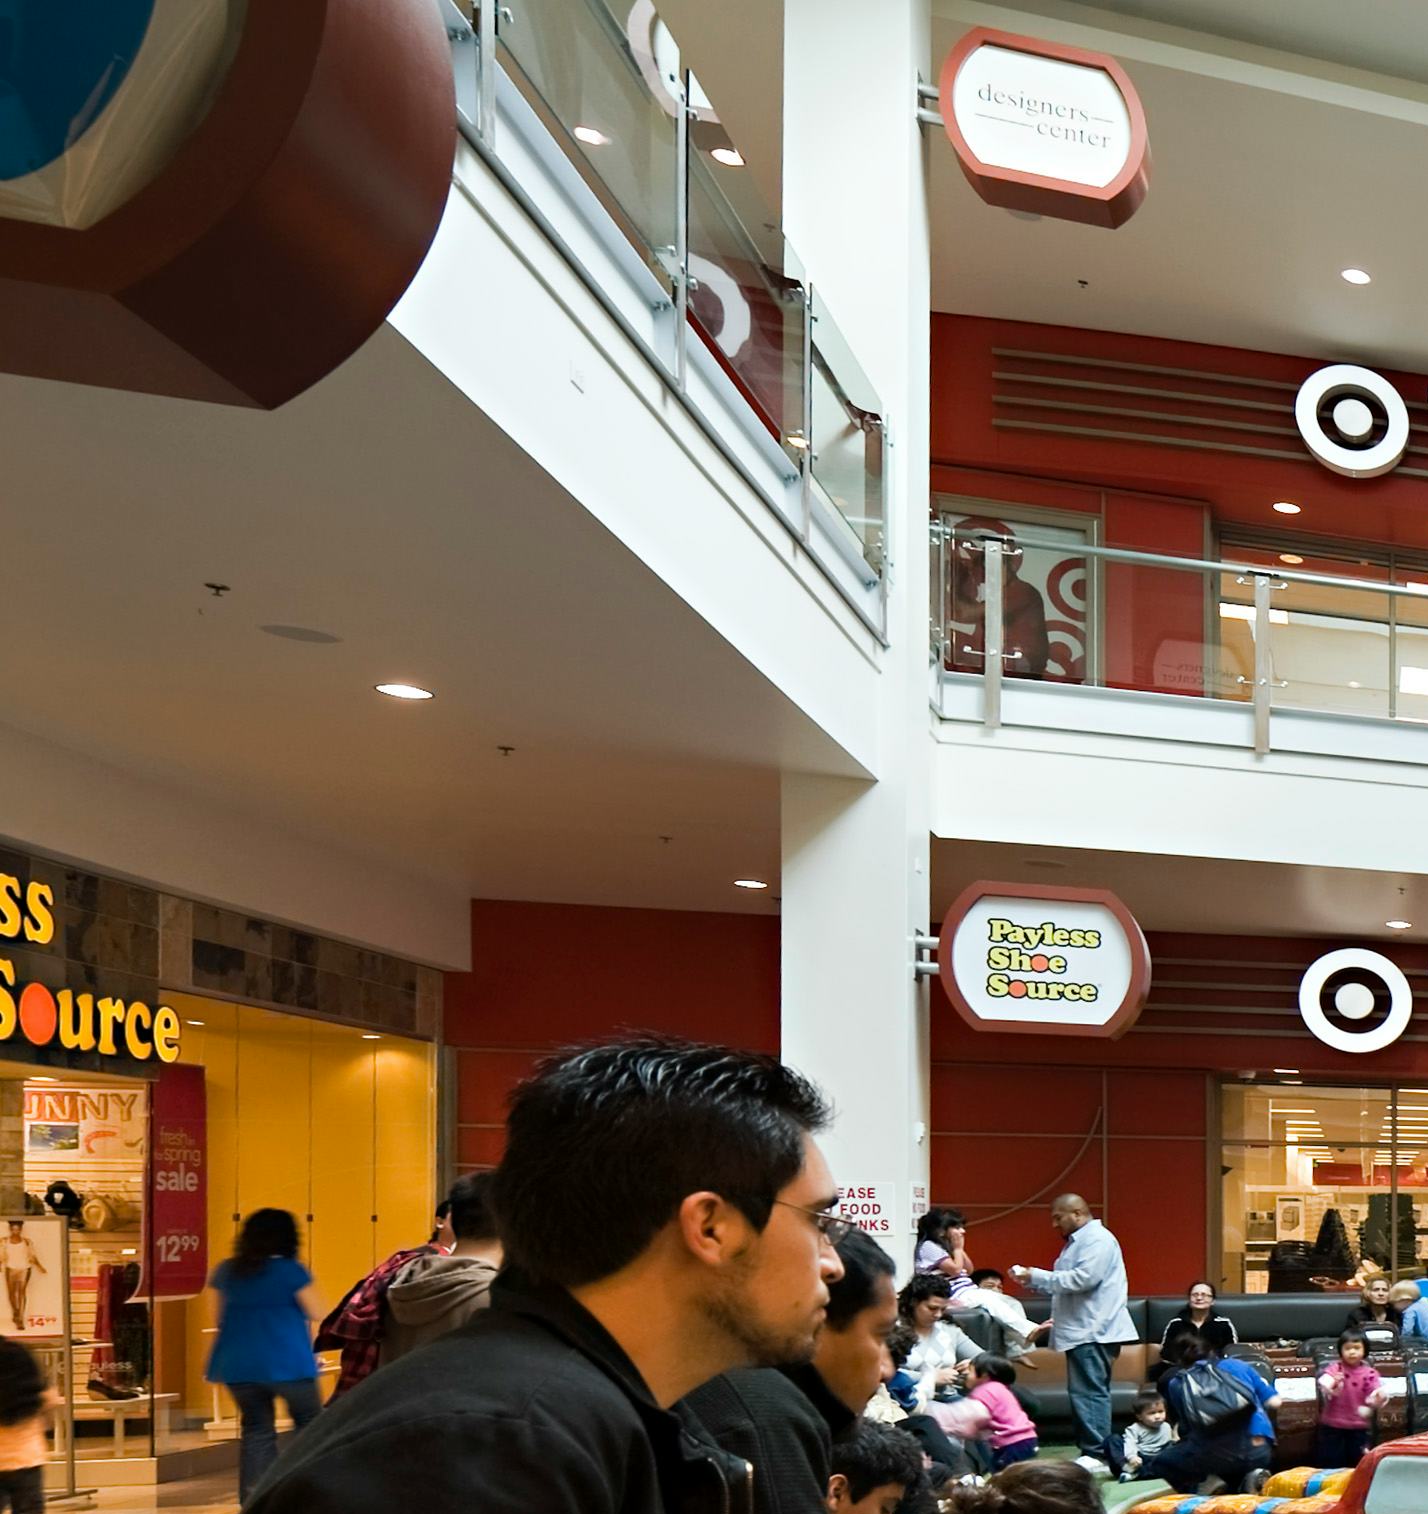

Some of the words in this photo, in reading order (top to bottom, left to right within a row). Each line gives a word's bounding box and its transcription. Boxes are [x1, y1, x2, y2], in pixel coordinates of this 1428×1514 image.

[977, 83, 1090, 122] designers
[1036, 123, 1112, 148] center
[987, 917, 1102, 950] Payless
[986, 945, 1068, 975] Shoe
[985, 972, 1099, 1003] Source
[163, 1148, 201, 1168] spring
[155, 1162, 198, 1192] sale
[838, 1187, 876, 1199] EASE
[840, 1203, 881, 1215] FOOD
[858, 1219, 890, 1231] NKS
